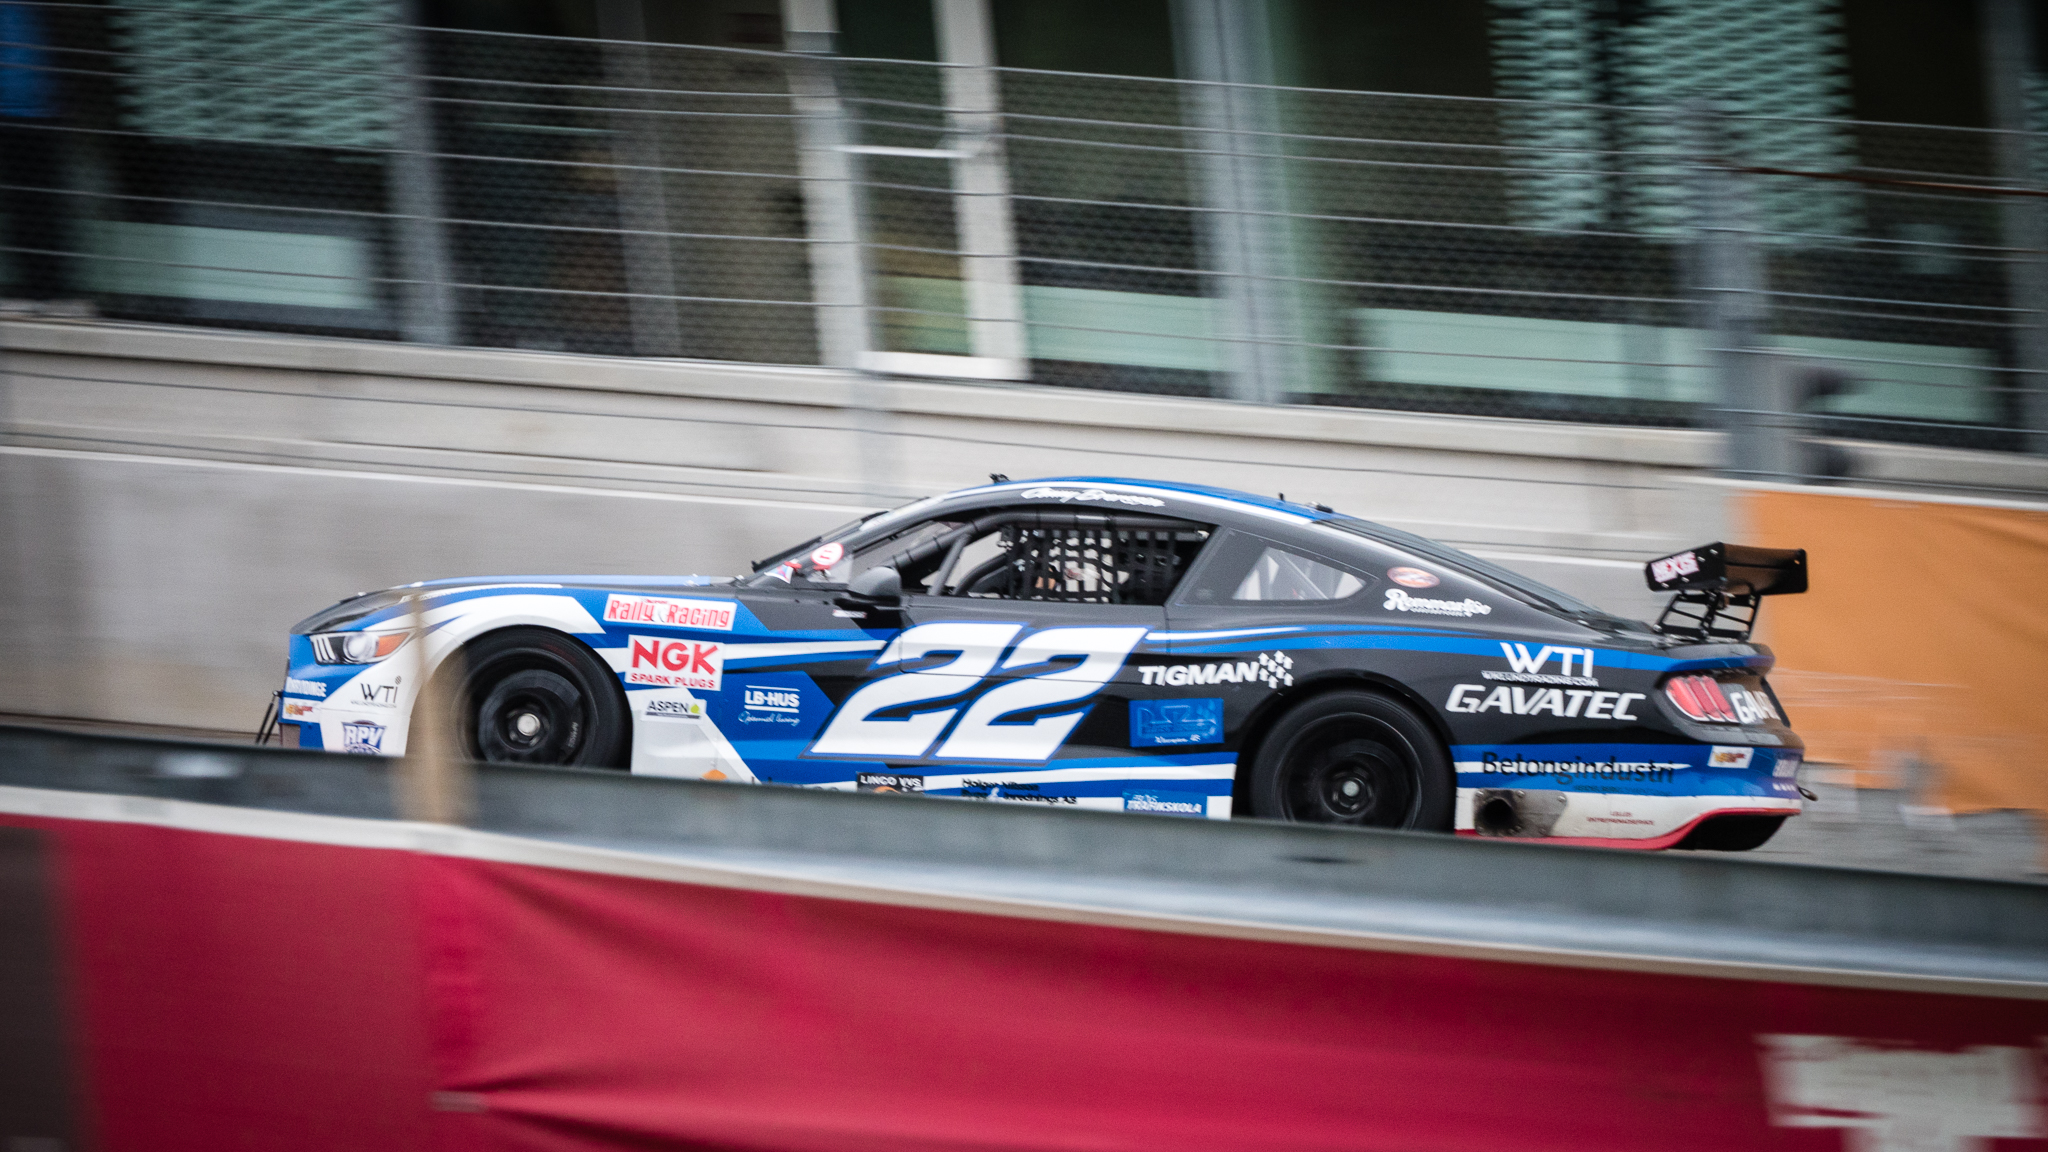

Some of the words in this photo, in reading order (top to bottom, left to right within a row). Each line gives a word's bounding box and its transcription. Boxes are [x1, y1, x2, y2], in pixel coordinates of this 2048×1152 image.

[608, 600, 655, 622] Rally
[666, 604, 731, 628] Racing
[631, 639, 719, 675] NGK
[1500, 641, 1594, 678] WTI
[630, 673, 671, 686] SPARK
[674, 676, 715, 690] PLUGS
[1138, 661, 1260, 687] TIGMAN
[360, 682, 399, 704] WTI
[744, 690, 800, 708] LB-HUS
[802, 621, 1152, 763] 22
[1445, 683, 1647, 721] GAVATEC
[646, 699, 690, 714] ASPEN
[344, 724, 385, 749] RPV
[1482, 751, 1674, 785] Betongindustri
[860, 774, 897, 787] LINCO
[898, 776, 922, 788] VVS
[1126, 799, 1202, 814] TRAFIKSKOLA
